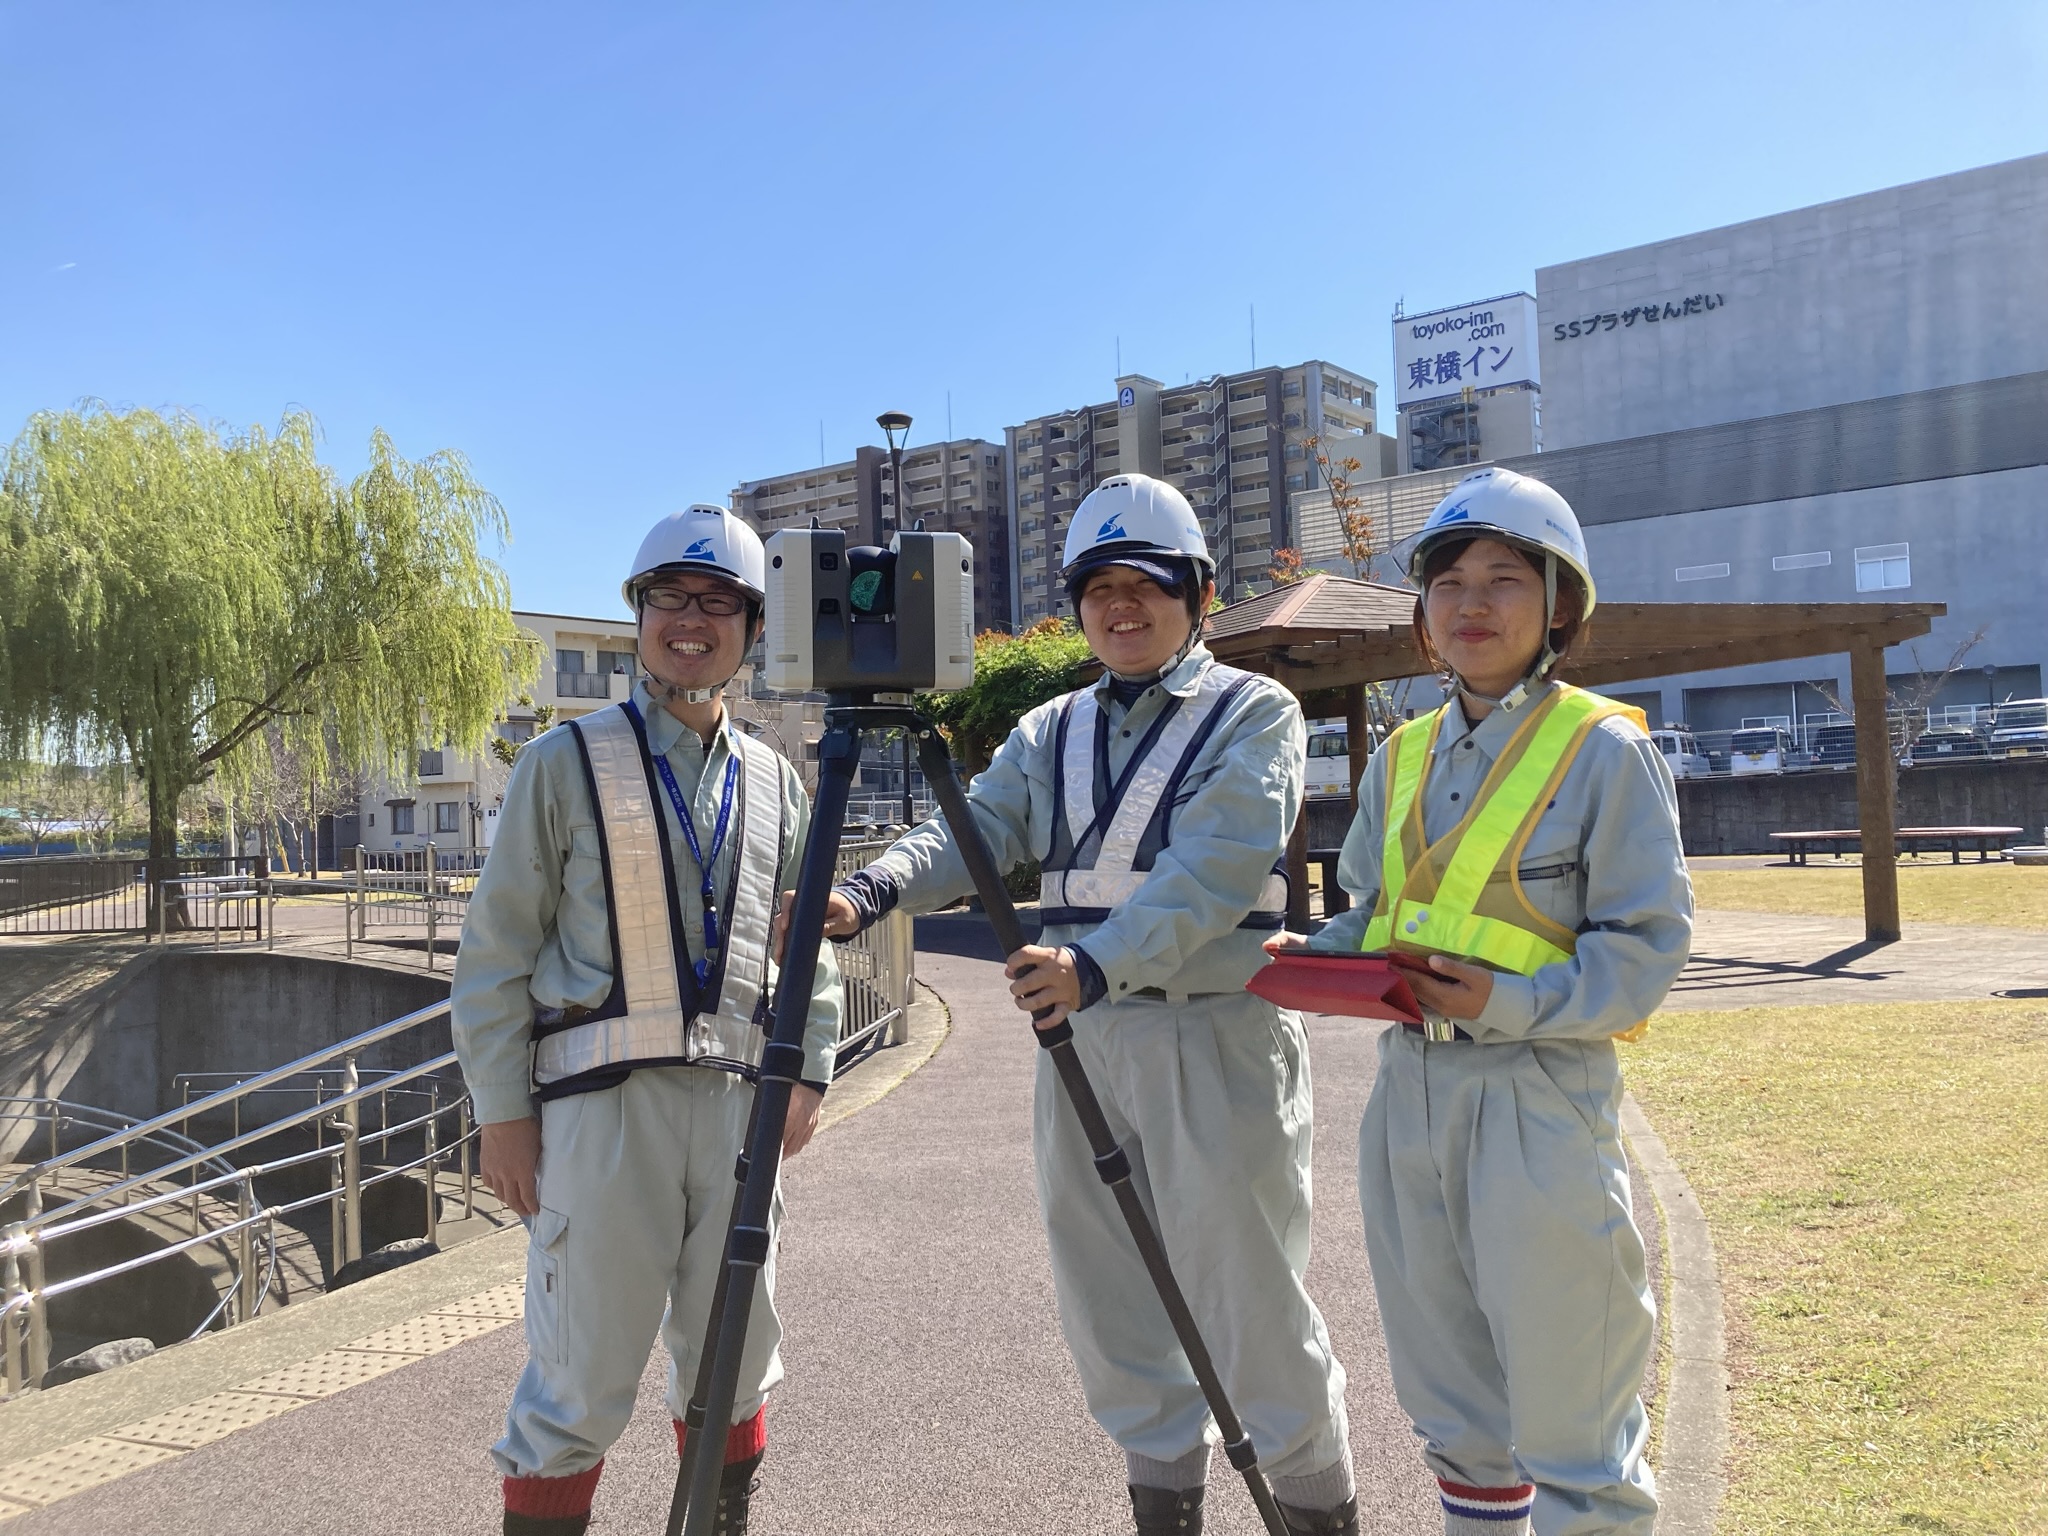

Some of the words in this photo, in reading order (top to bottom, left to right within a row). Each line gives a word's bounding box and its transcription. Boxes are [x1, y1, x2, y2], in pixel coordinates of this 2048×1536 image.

[1412, 311, 1494, 340] toyoko-inn
[1468, 322, 1505, 342] .com
[1554, 293, 1725, 341] SSプラザせんだい
[1407, 346, 1514, 390] 東横イン
